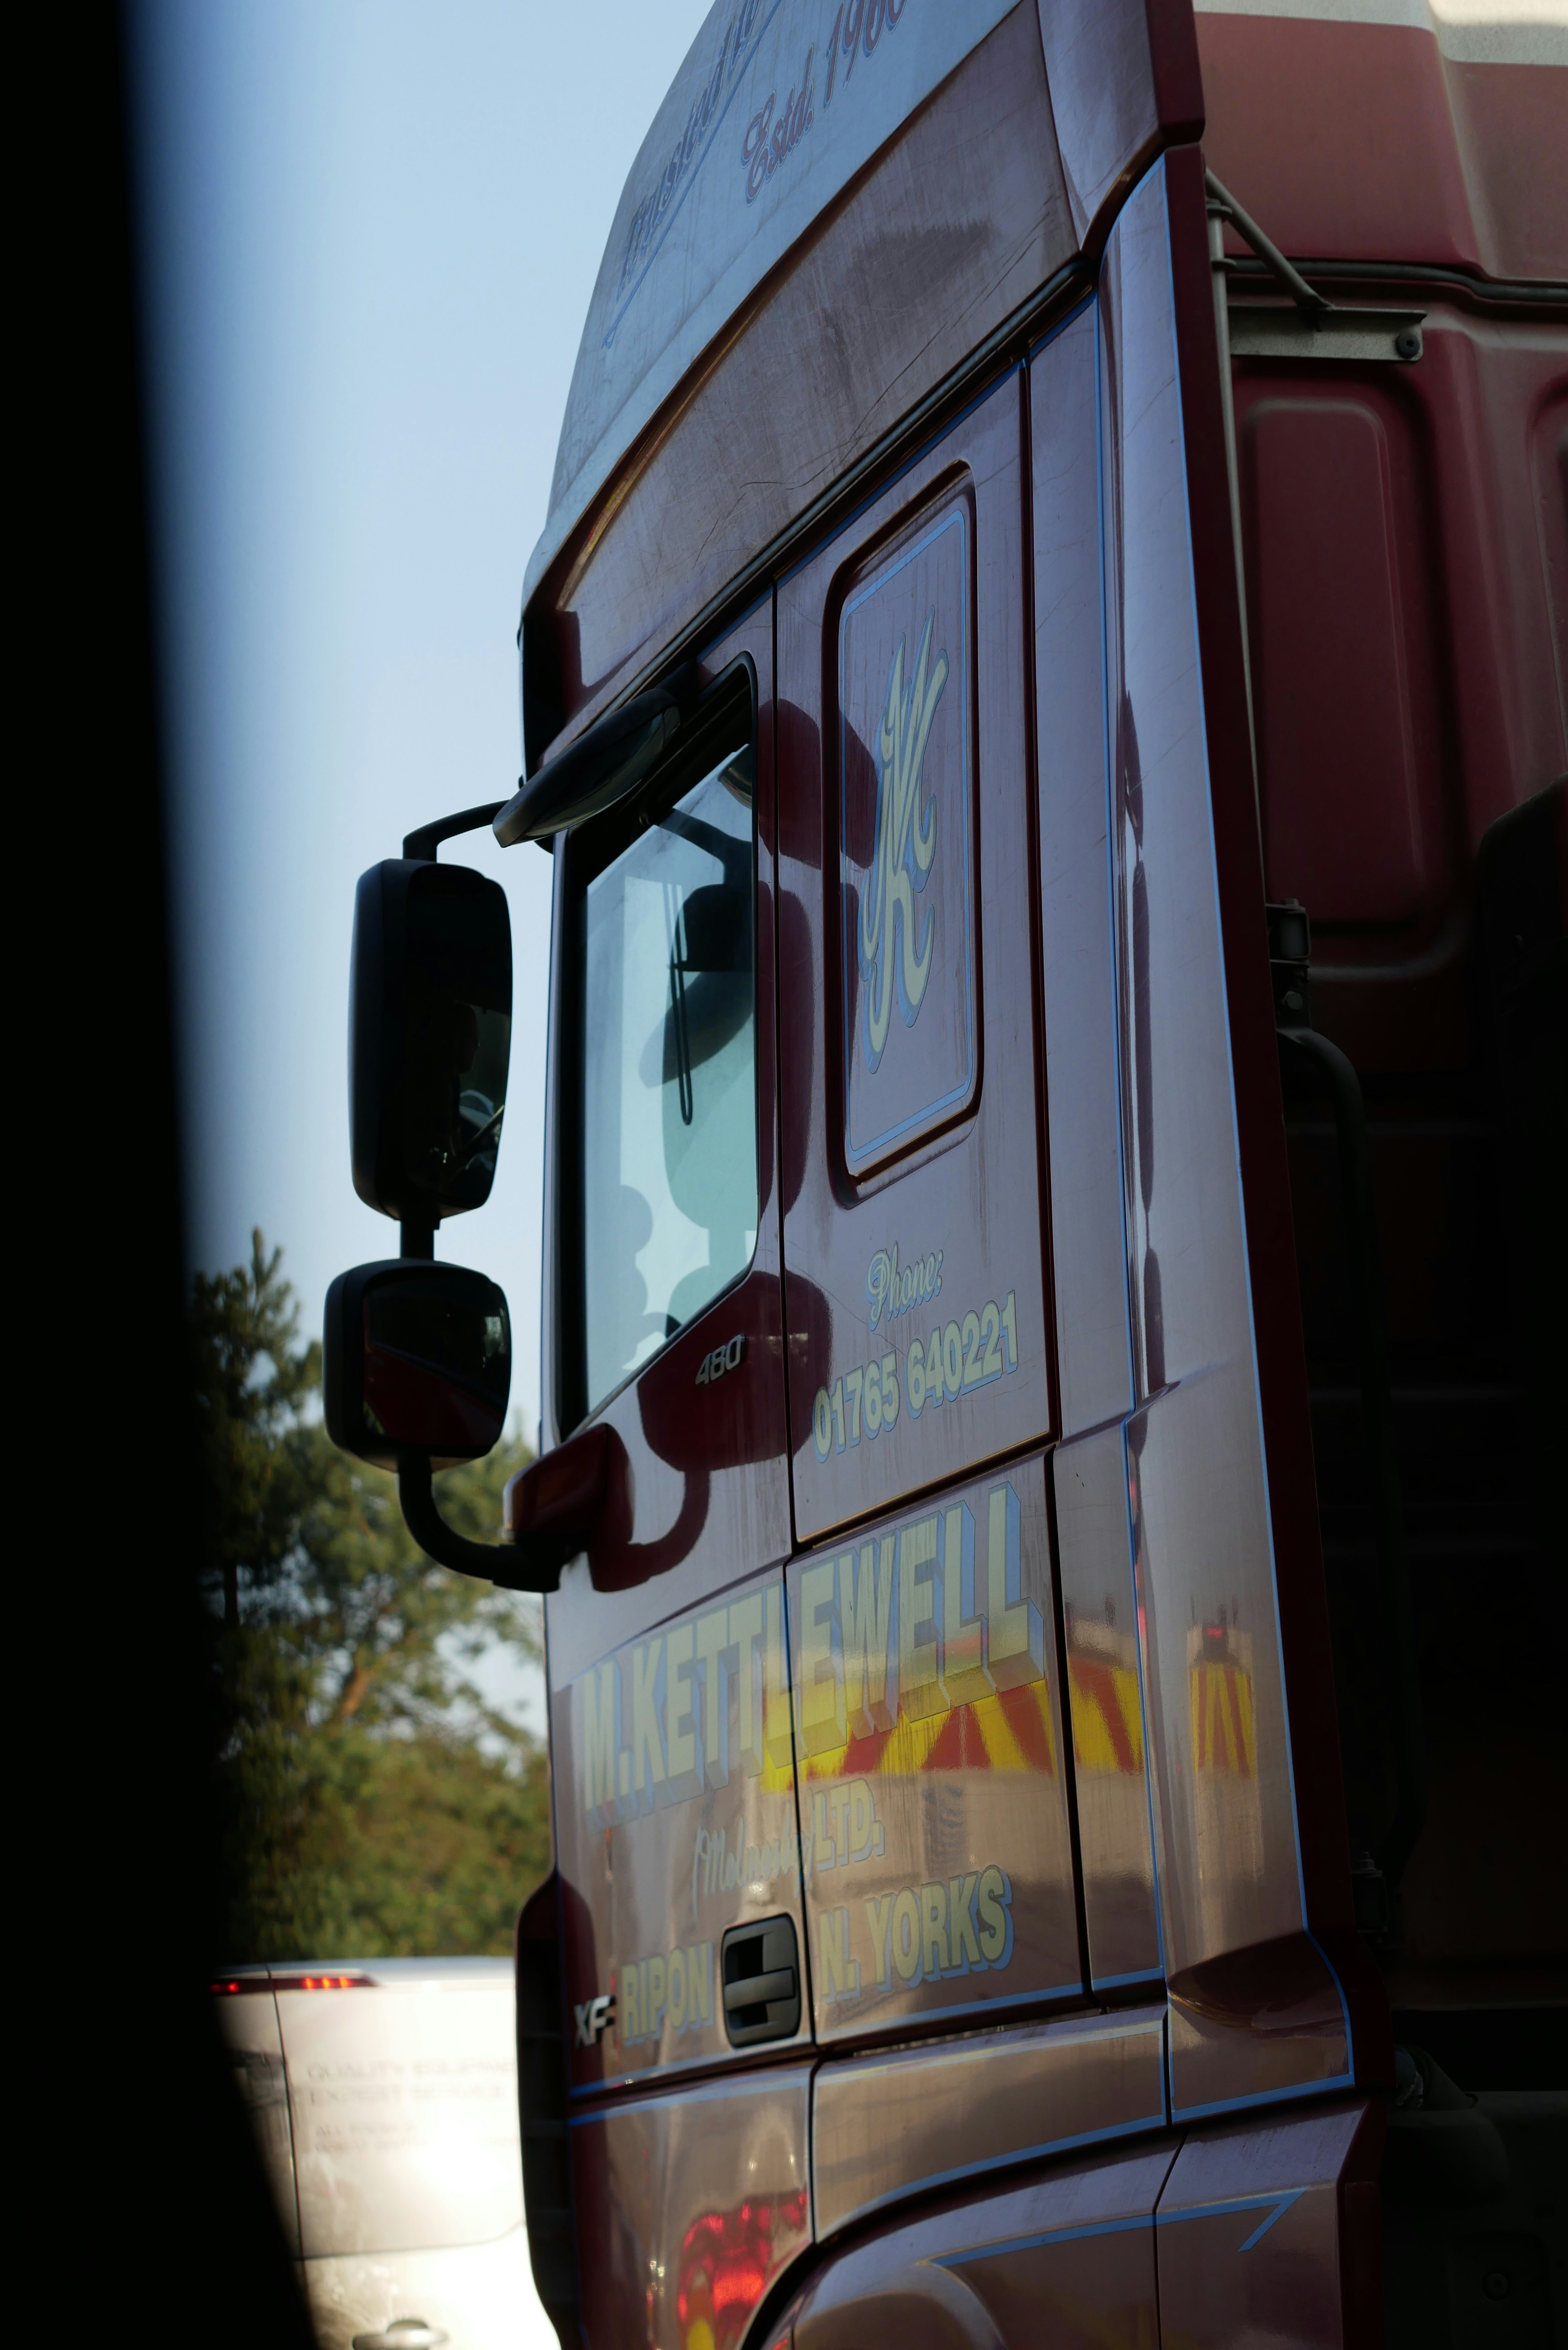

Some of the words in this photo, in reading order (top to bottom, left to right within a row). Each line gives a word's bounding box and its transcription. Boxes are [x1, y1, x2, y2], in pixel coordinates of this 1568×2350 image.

[695, 1332, 746, 1385] 480
[813, 1350, 900, 1463] 01765
[907, 1290, 1018, 1419] 640221
[814, 1778, 885, 1872] LTD.
[620, 1941, 714, 2047] RIPON
[819, 1905, 861, 2004] N.
[864, 1864, 1014, 1990] YORKS
[574, 1994, 615, 2048] XF
